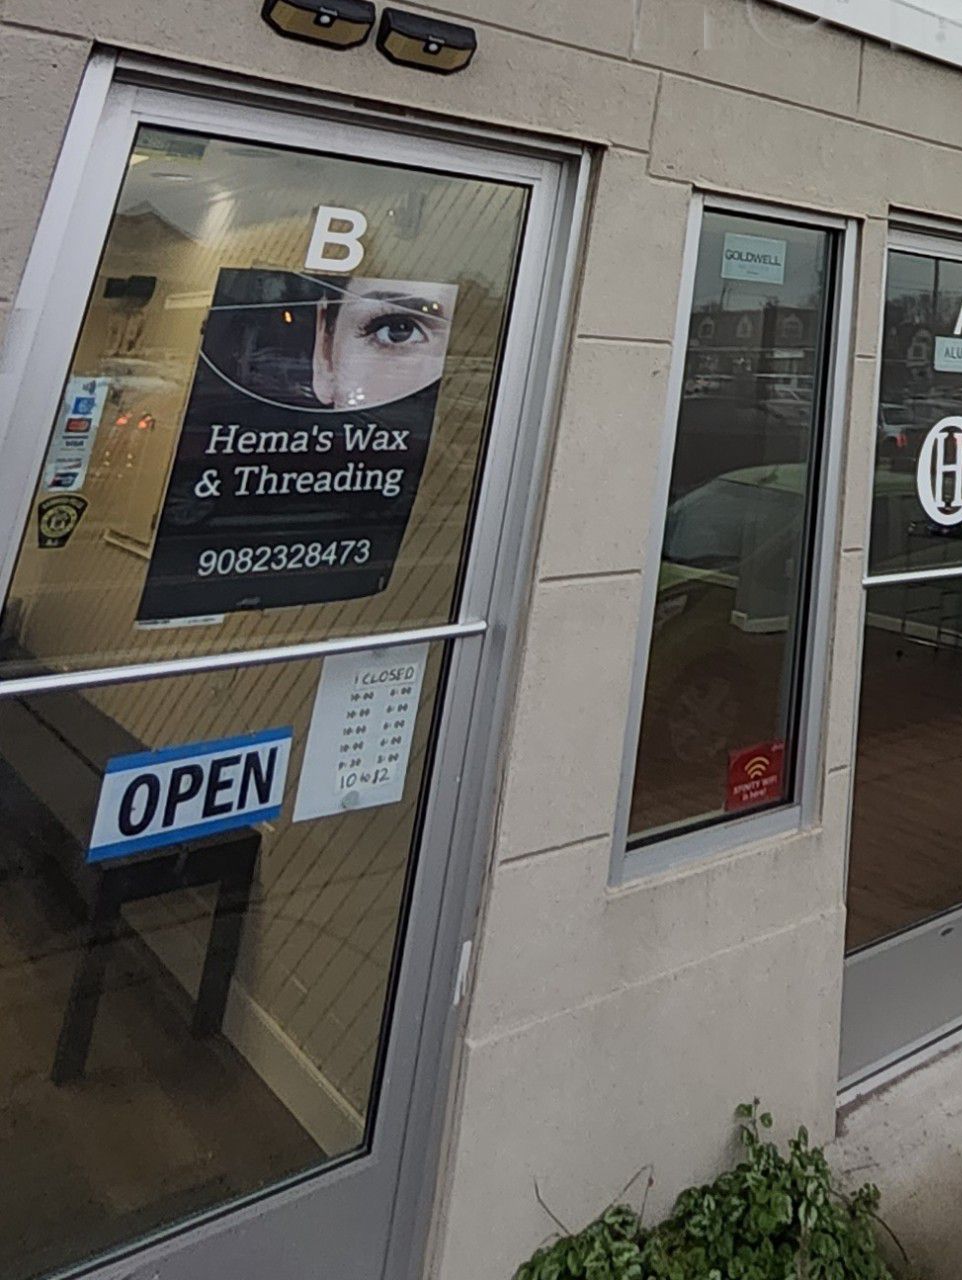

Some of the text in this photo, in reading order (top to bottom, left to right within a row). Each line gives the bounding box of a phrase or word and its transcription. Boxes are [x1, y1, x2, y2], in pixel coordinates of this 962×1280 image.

[304, 204, 368, 273] B
[725, 248, 782, 267] GOLDWELL
[205, 423, 410, 455] Hema's Wax
[194, 463, 404, 498] & Threading
[197, 539, 371, 576] 9082328473
[362, 666, 414, 685] CLOSED
[118, 746, 278, 837] OPEN
[340, 773, 357, 789] 10
